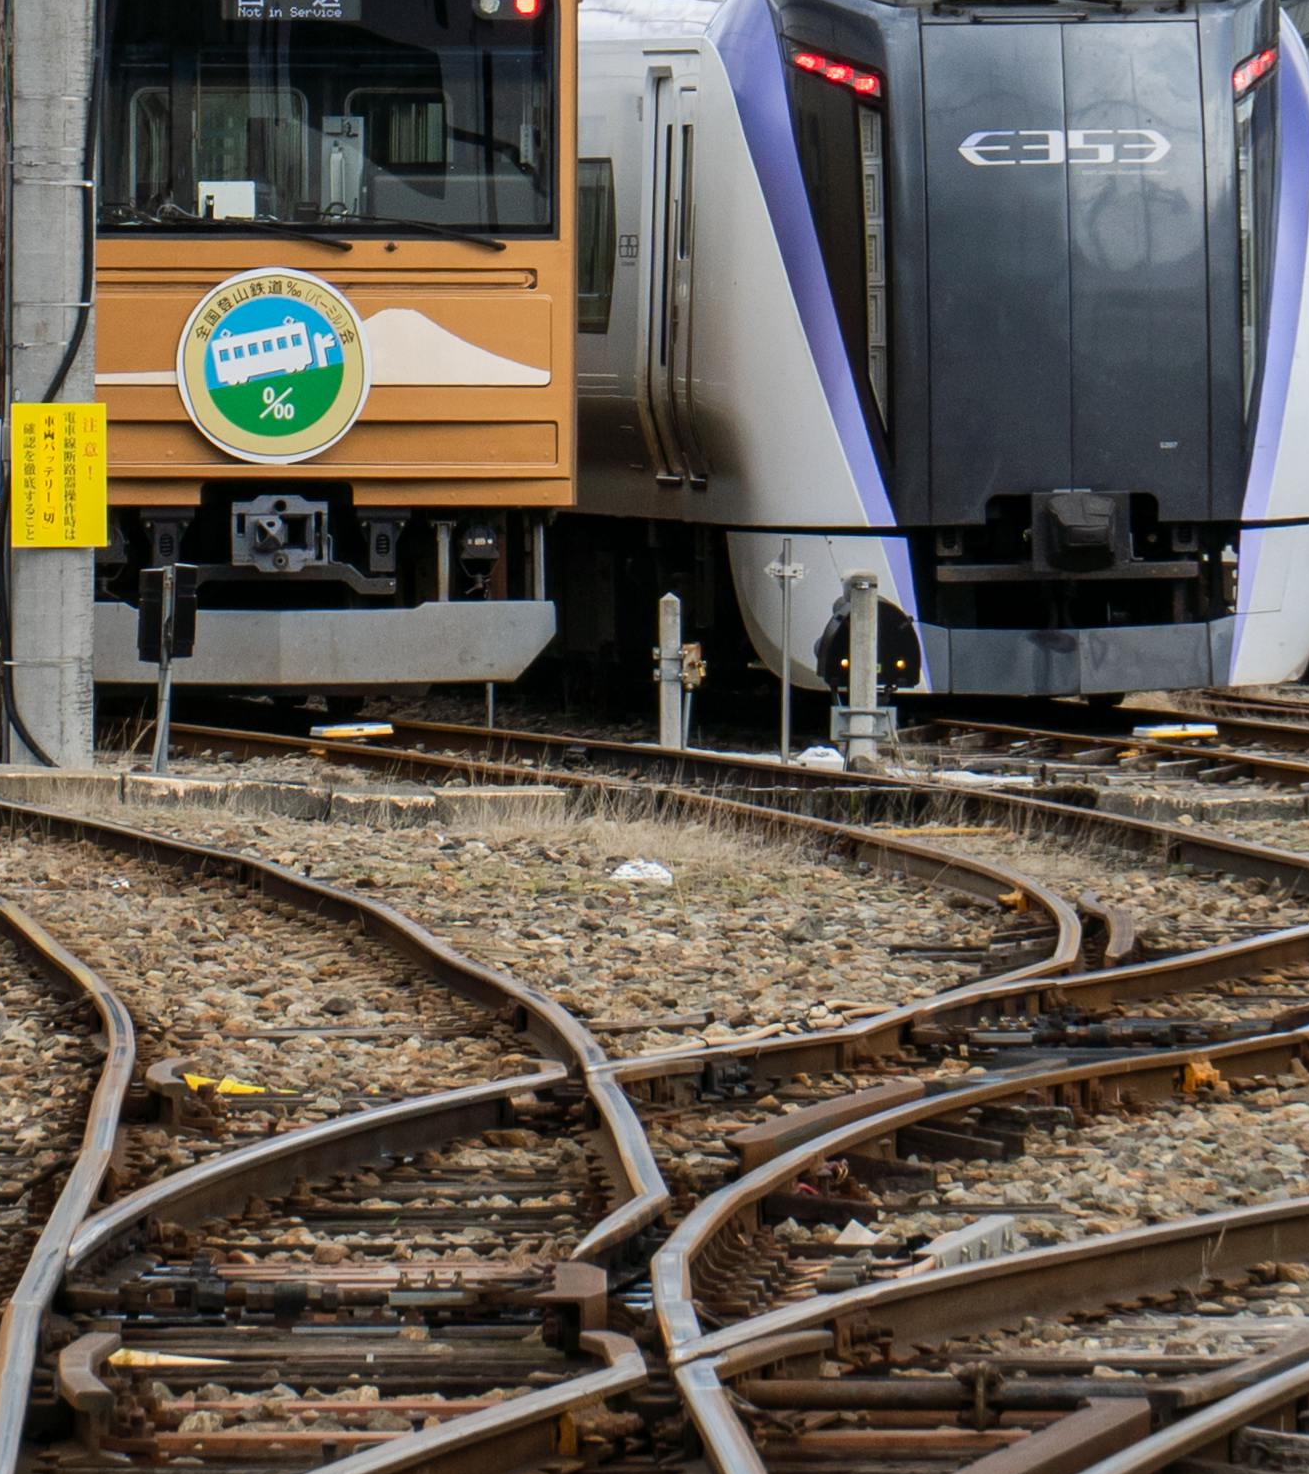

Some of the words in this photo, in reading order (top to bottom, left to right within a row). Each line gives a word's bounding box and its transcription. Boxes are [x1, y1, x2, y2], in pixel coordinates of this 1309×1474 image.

[237, 6, 262, 18] Not
[269, 6, 283, 18] in
[290, 6, 342, 18] Service
[957, 129, 1172, 166] E353
